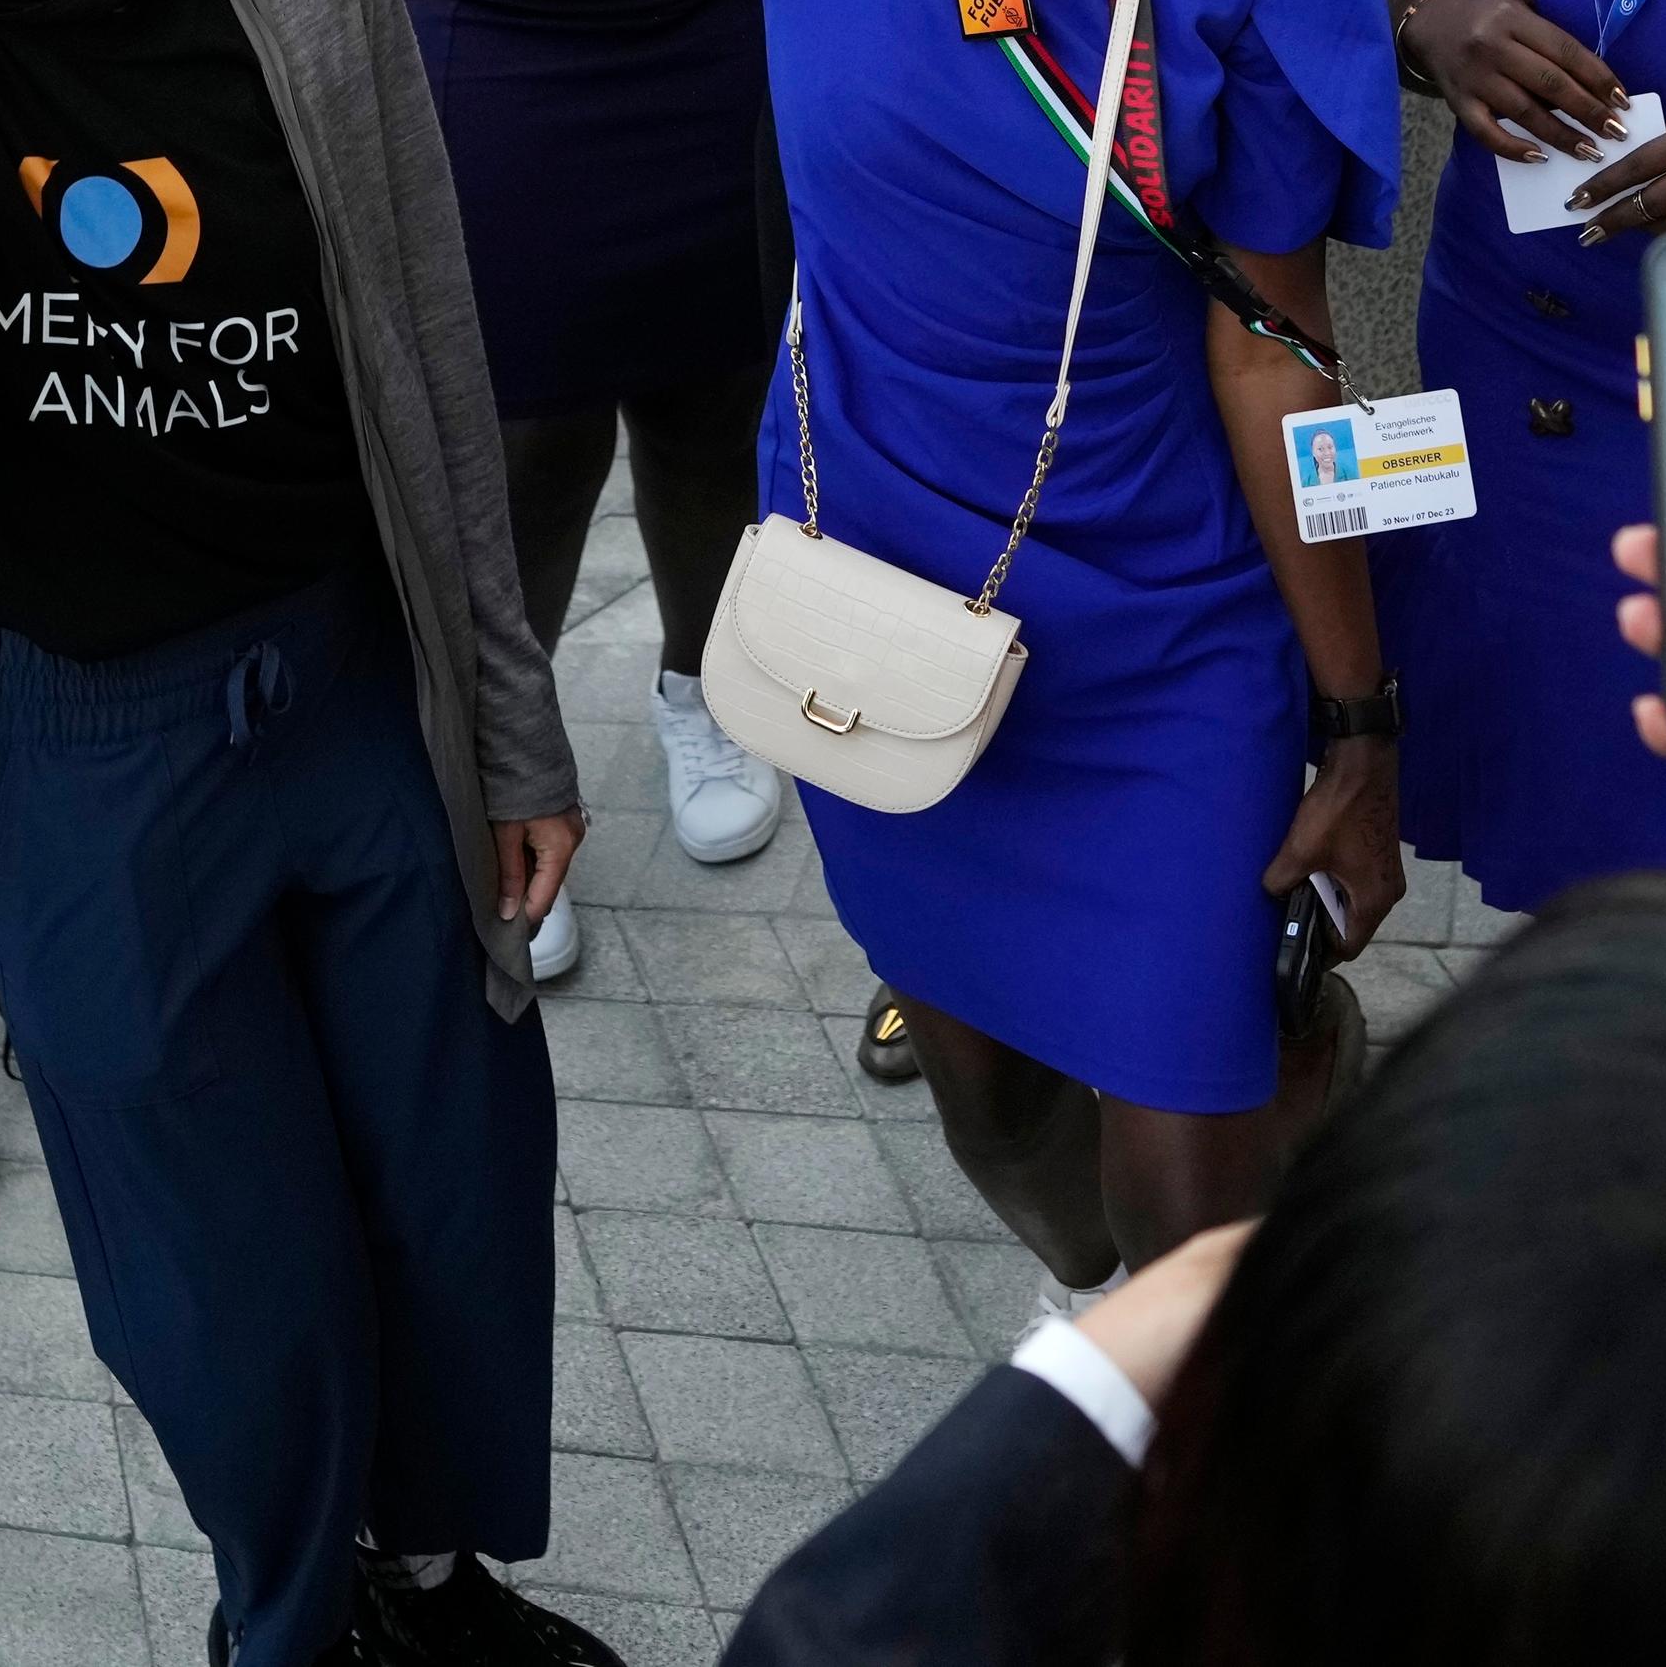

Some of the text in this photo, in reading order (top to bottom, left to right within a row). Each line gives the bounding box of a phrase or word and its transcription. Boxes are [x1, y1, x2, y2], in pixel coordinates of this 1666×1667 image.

[169, 307, 299, 365] FOR
[1375, 415, 1437, 431] Evangelisches
[1381, 426, 1434, 441] Studienwerk
[1382, 452, 1442, 470] OBSERVER
[1370, 469, 1460, 491] Patience Nabukalu
[1382, 517, 1393, 526] 30
[1394, 515, 1410, 524] Nov
[1416, 512, 1425, 521] 07
[1427, 510, 1443, 519] Dec
[1445, 507, 1455, 516] 23
